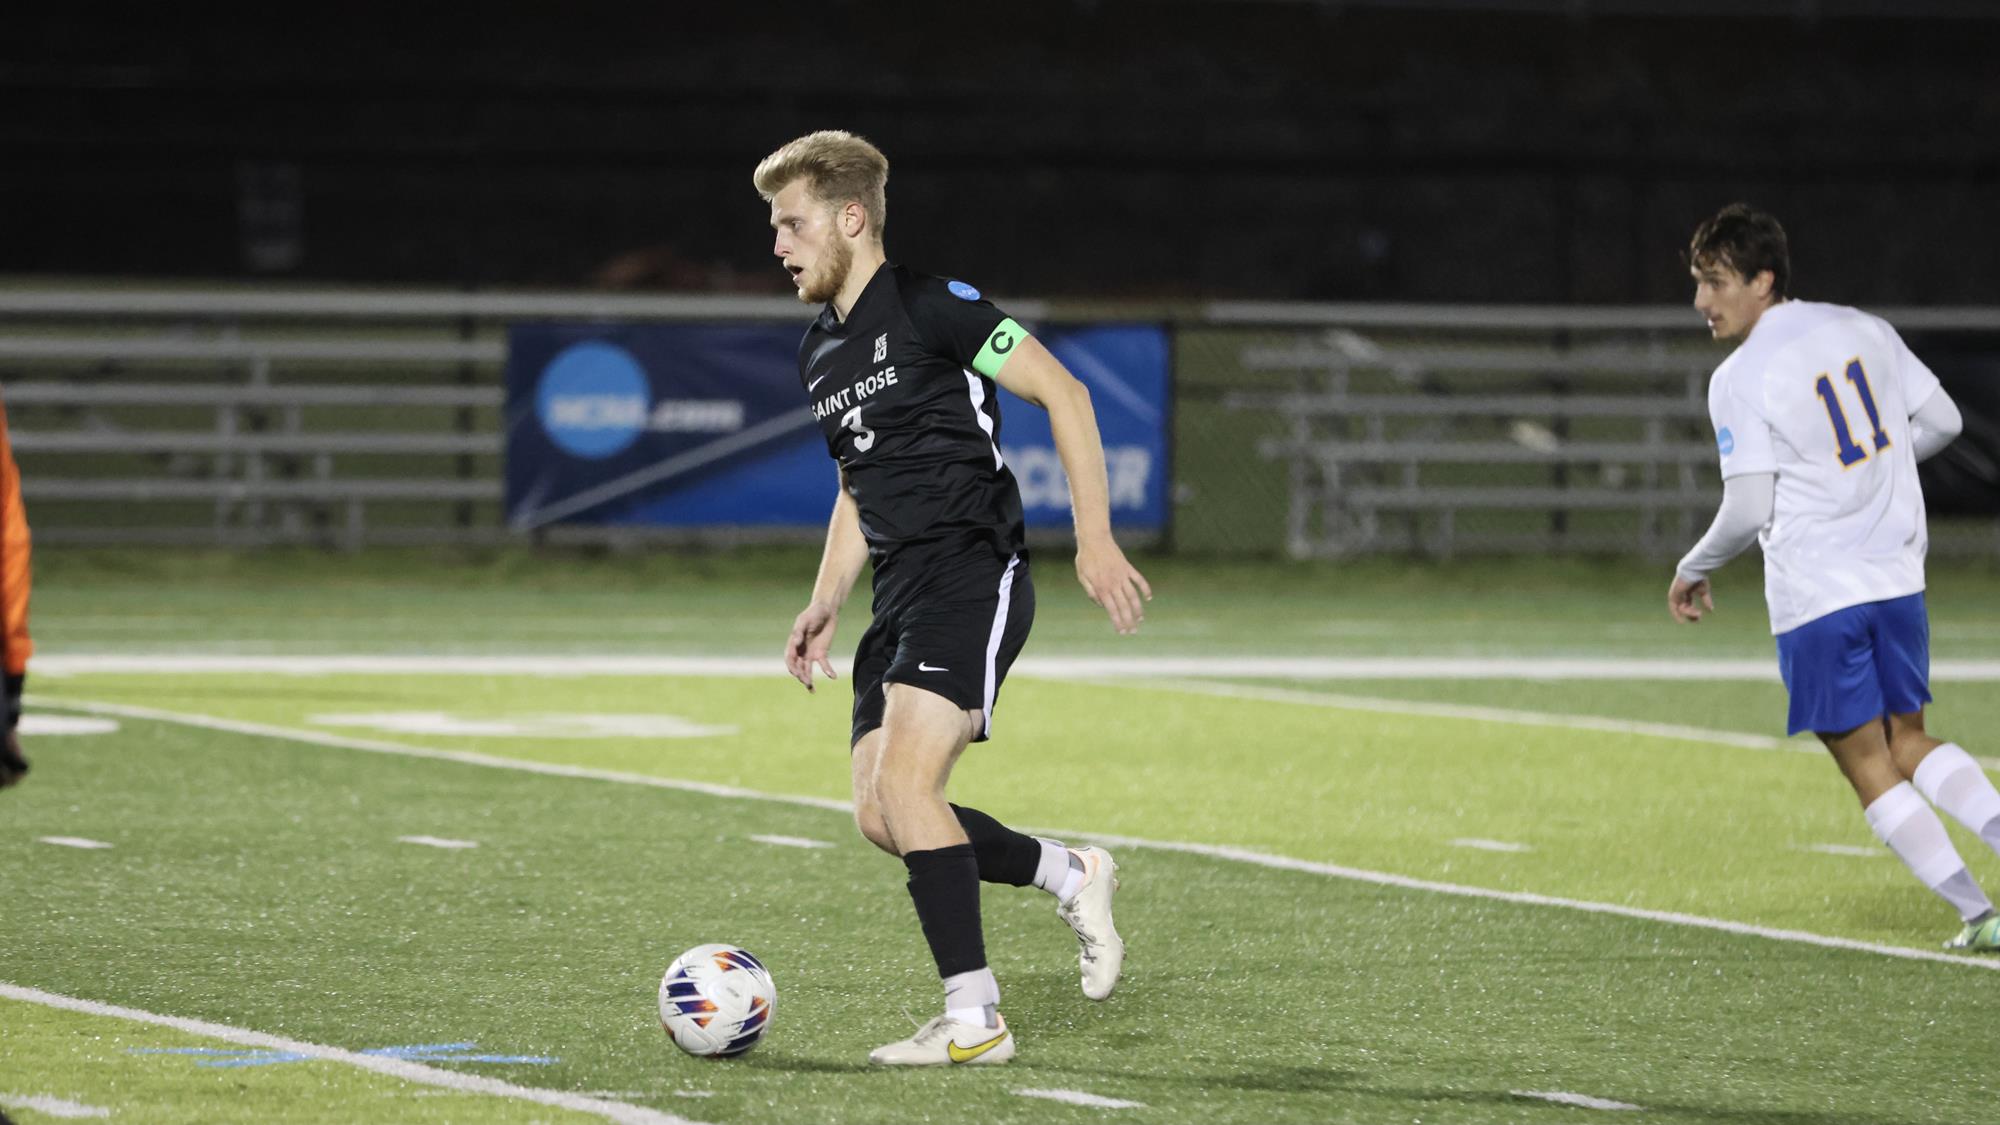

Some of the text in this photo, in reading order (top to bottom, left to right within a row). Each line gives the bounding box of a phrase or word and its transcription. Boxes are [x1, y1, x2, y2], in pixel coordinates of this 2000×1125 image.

[990, 331, 1014, 355] C
[855, 365, 898, 401] ROSE
[840, 405, 876, 453] 3
[1815, 355, 1893, 471] 11
